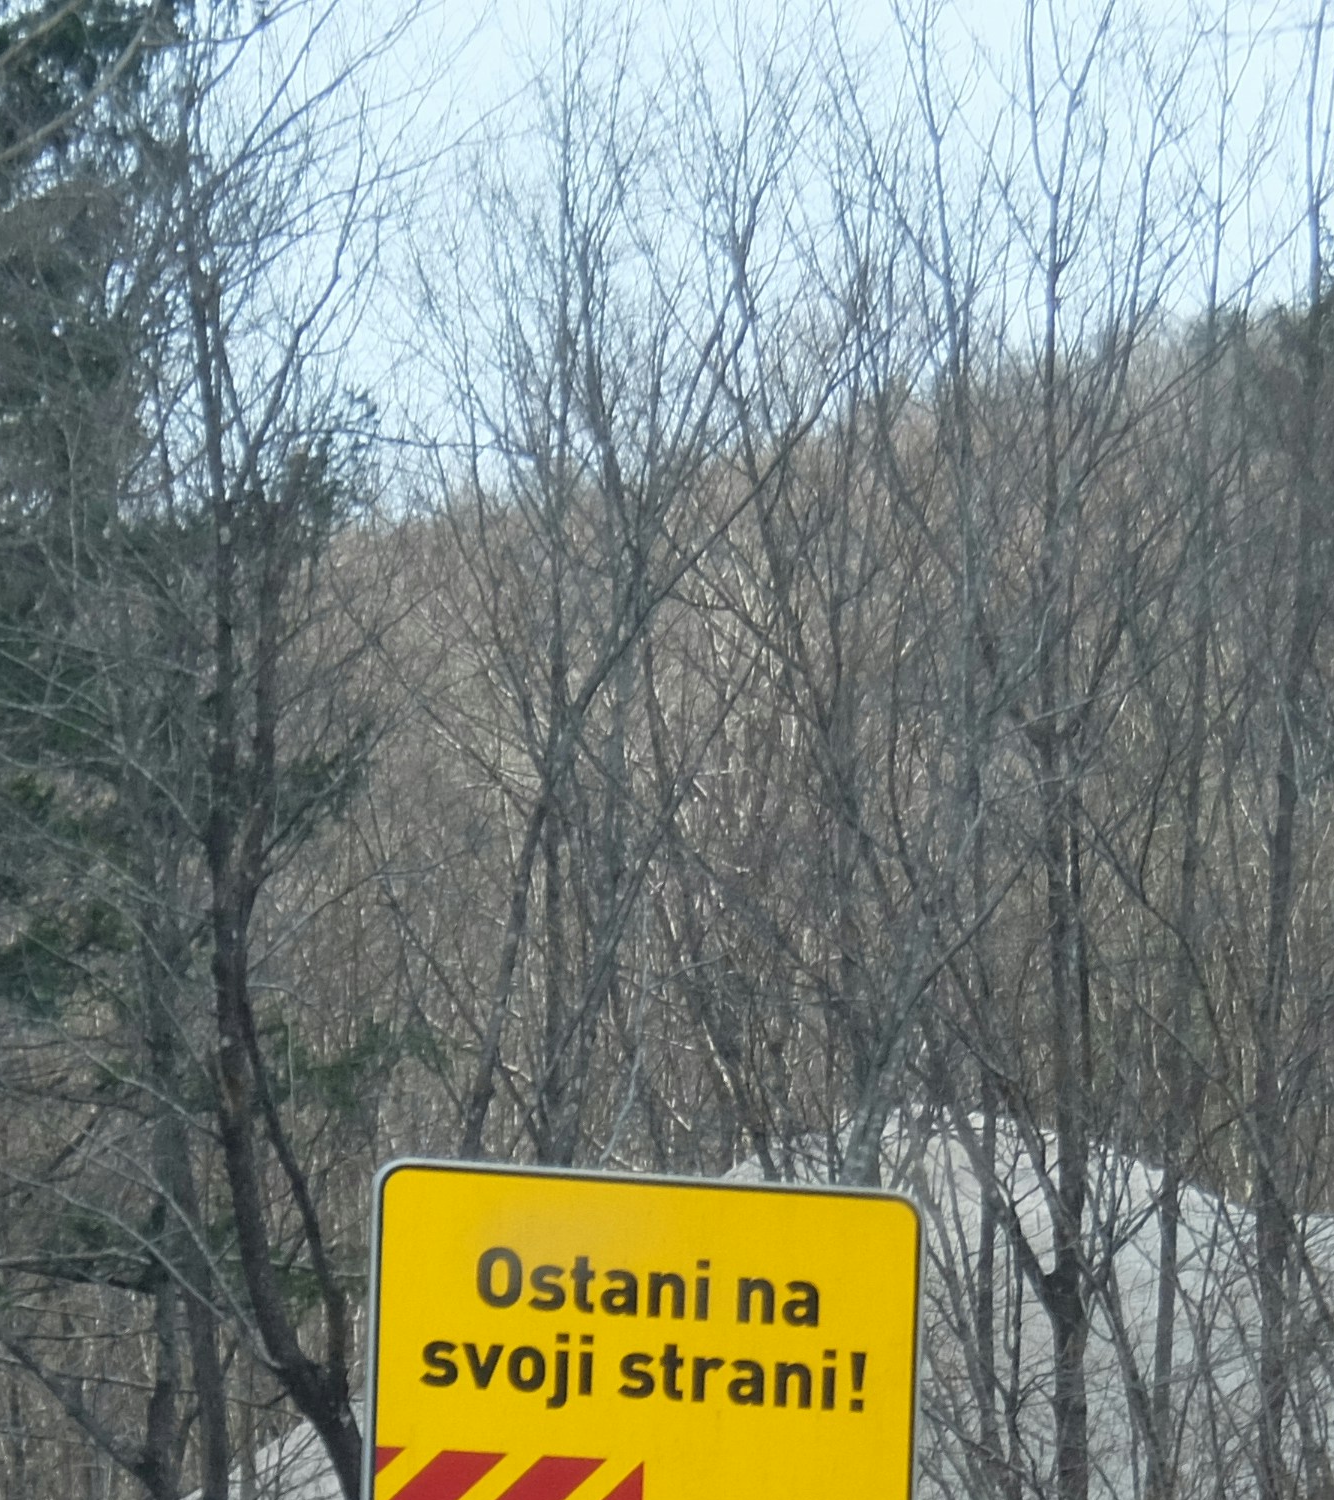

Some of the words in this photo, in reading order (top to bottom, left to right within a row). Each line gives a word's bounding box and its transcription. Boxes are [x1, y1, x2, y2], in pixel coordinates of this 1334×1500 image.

[476, 1247, 711, 1321] Ostani
[736, 1276, 821, 1328] na
[420, 1333, 595, 1409] svoji
[618, 1343, 868, 1412] strani!
